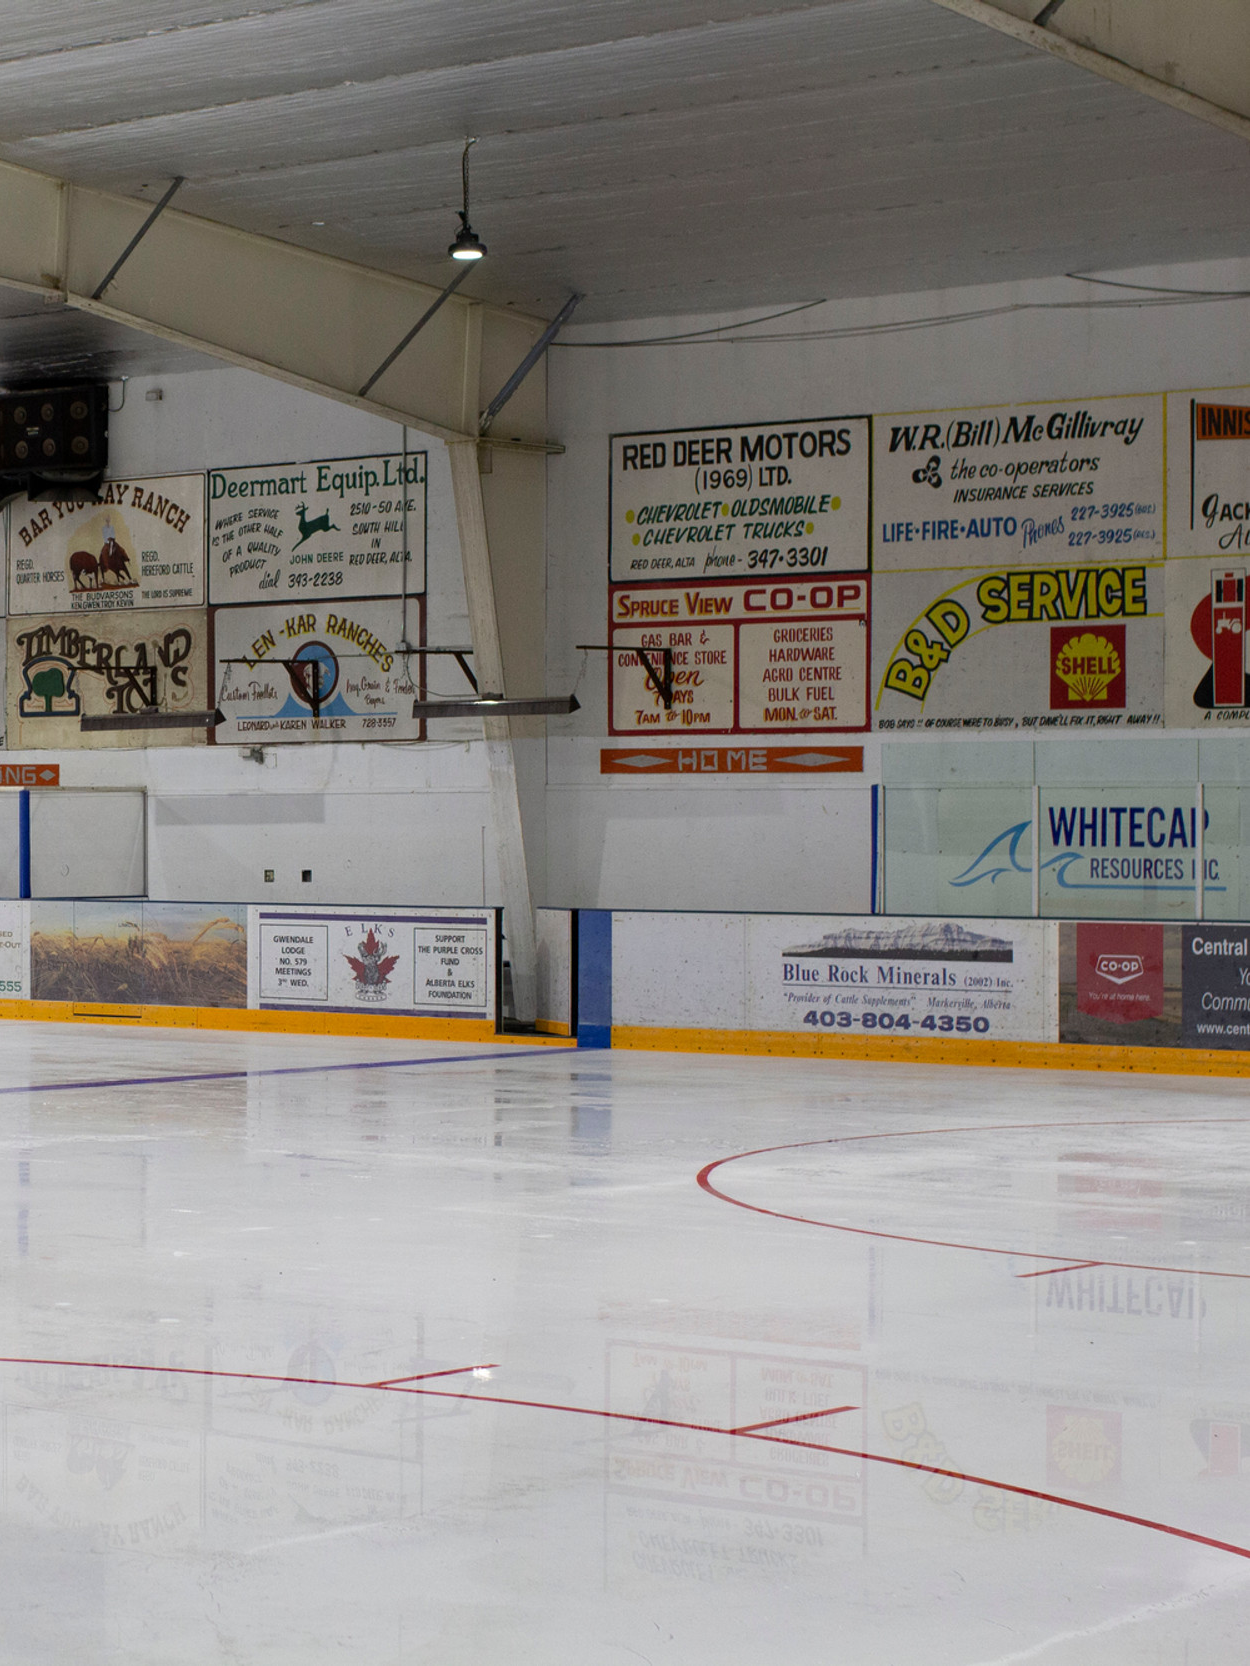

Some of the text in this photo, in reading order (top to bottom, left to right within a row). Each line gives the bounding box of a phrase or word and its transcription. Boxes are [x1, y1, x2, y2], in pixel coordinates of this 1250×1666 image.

[622, 428, 851, 470] RED DEER MOTORS
[950, 451, 1100, 483] the co-operators
[211, 457, 425, 499] Deermart Equip. Ltd.
[694, 464, 792, 495] (1969) LTD.
[953, 481, 1094, 503] INSURANCE SERVICES
[131, 486, 191, 534] RANCH
[215, 508, 280, 530] WHERE SERVICE
[636, 495, 831, 525] CHEVROLET OLDSMOBILE
[1071, 502, 1134, 521] 227-3925
[18, 508, 52, 547] BAR
[222, 532, 235, 544] THE
[238, 522, 261, 536] OTHER
[352, 521, 380, 535] SOUTH
[643, 520, 805, 546] CHEVROLET TRUCKS
[1068, 528, 1132, 547] 227-3925
[229, 559, 267, 577] PRODUCT
[289, 552, 344, 565] JOHN DEERE
[349, 553, 365, 566] RED
[630, 559, 648, 570] RED
[43, 571, 65, 582] HORSES
[173, 563, 194, 574] CATTLE
[616, 584, 861, 618] SPRUCE VIEW CO-OP
[977, 566, 1147, 624] SERVICE
[326, 613, 394, 673] RANCHES
[641, 633, 662, 648] GAS
[669, 632, 692, 647] BAR
[773, 627, 833, 643] GROCERIES
[694, 651, 727, 665] STORE
[769, 647, 835, 662] HARDWARE
[884, 598, 970, 701] B&D
[762, 667, 842, 683] AGRO CENTRE
[1061, 656, 1118, 675] SHELL
[768, 687, 834, 702] BULK FUEL
[764, 707, 837, 722] MON. SAT.
[678, 750, 767, 771] HOME
[1048, 806, 1210, 848] WHITECAP
[1089, 858, 1184, 880] RESOURCES
[273, 935, 314, 944] GWENDALE
[435, 935, 465, 943] SUPPORT
[1192, 937, 1248, 956] Central
[281, 946, 305, 955] LODGE
[418, 946, 483, 955] THE PURPLE CROSS
[275, 967, 312, 976] MEETINGS
[440, 958, 460, 966] FUND
[425, 979, 475, 988] ALBERTA ELKS
[782, 963, 820, 982] Blue
[828, 965, 869, 983] Rock
[877, 966, 957, 986] Minerals
[428, 991, 472, 1000] FOUNDATION
[823, 993, 832, 1005] of
[803, 1010, 990, 1033] 403-804-4350
